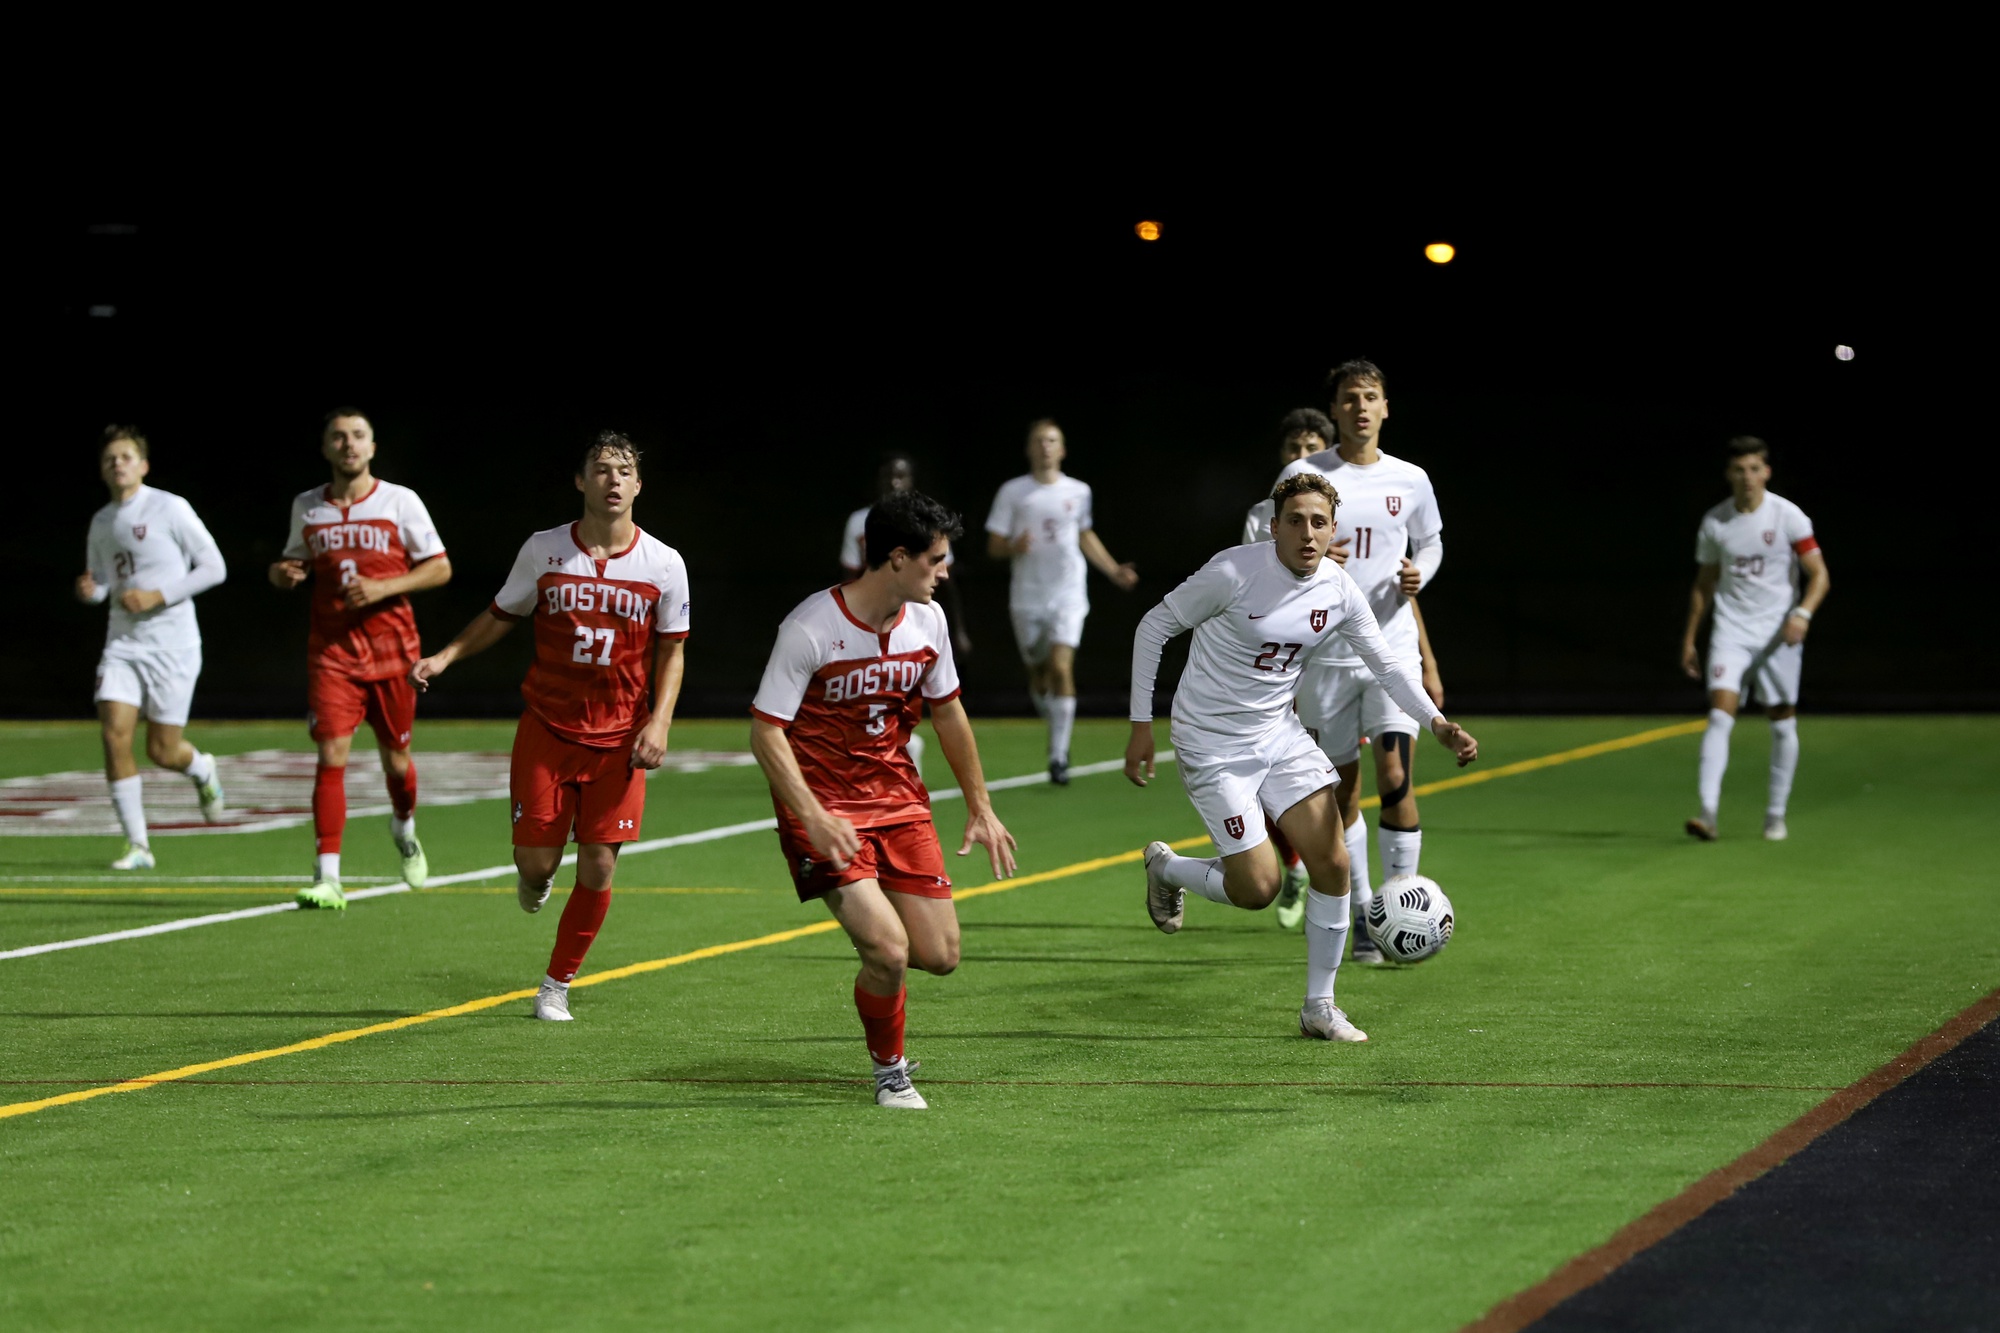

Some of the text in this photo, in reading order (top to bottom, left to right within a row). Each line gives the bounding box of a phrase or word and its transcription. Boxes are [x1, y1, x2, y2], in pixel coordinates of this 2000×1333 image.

[308, 523, 391, 555] BOSTON
[1355, 527, 1372, 559] 11
[114, 550, 135, 579] 21
[545, 582, 652, 625] BOSTON
[572, 625, 615, 666] 27
[1253, 642, 1303, 672] 27
[866, 704, 888, 736] 5
